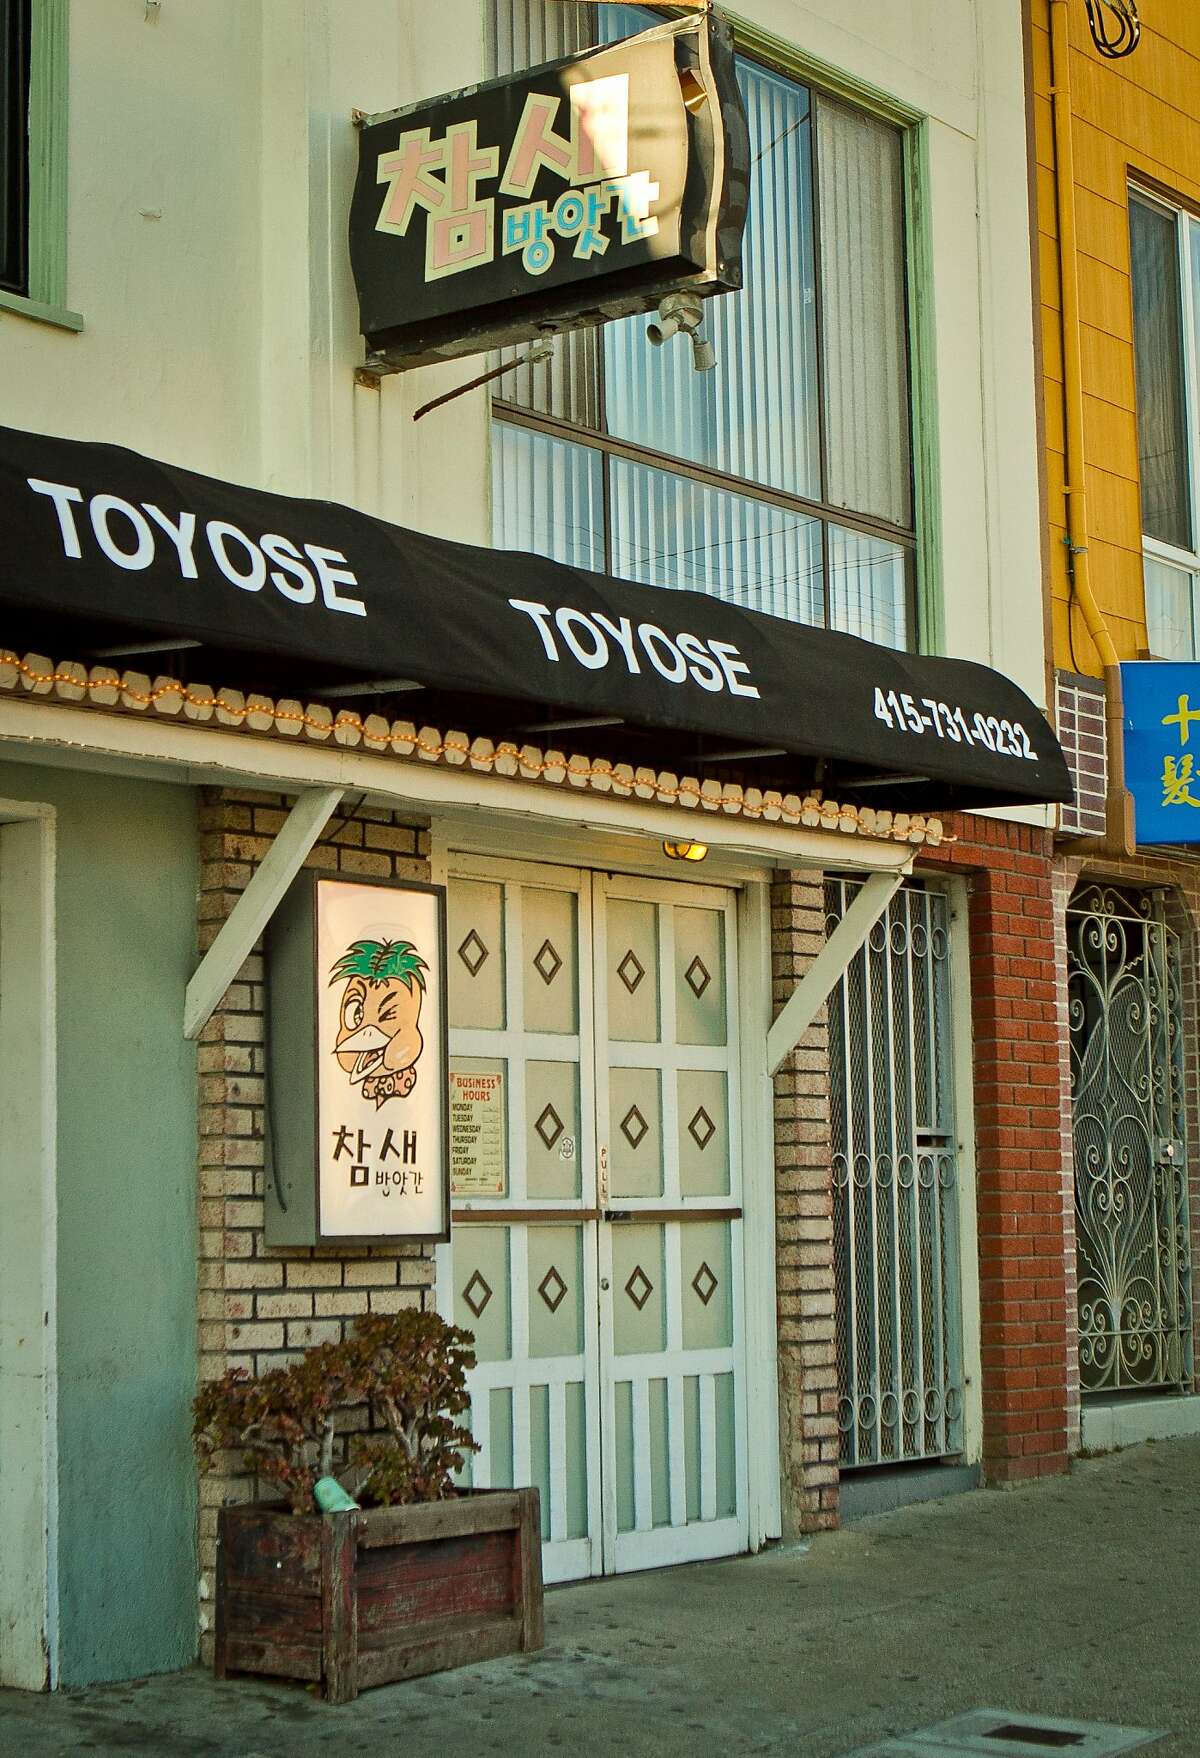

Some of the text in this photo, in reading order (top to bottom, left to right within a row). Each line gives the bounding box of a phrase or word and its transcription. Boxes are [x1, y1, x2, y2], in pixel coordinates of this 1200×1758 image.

[27, 478, 366, 616] TOYOSE
[508, 598, 760, 698] TOYOSE
[874, 686, 1039, 761] 415-731-0232
[462, 1090, 491, 1102] HOURS
[452, 1103, 473, 1112] MONDAY
[452, 1114, 473, 1122] TUESDAY
[452, 1125, 481, 1133] WEDNESDAY
[452, 1135, 477, 1144] THURSDAY
[452, 1146, 469, 1154] FRIDAY
[332, 1124, 417, 1187] 참새
[452, 1157, 477, 1165] SATURDAY
[452, 1167, 472, 1176] SUNDAY
[600, 1148, 608, 1194] PULL
[375, 1171, 423, 1197] 방앗간
